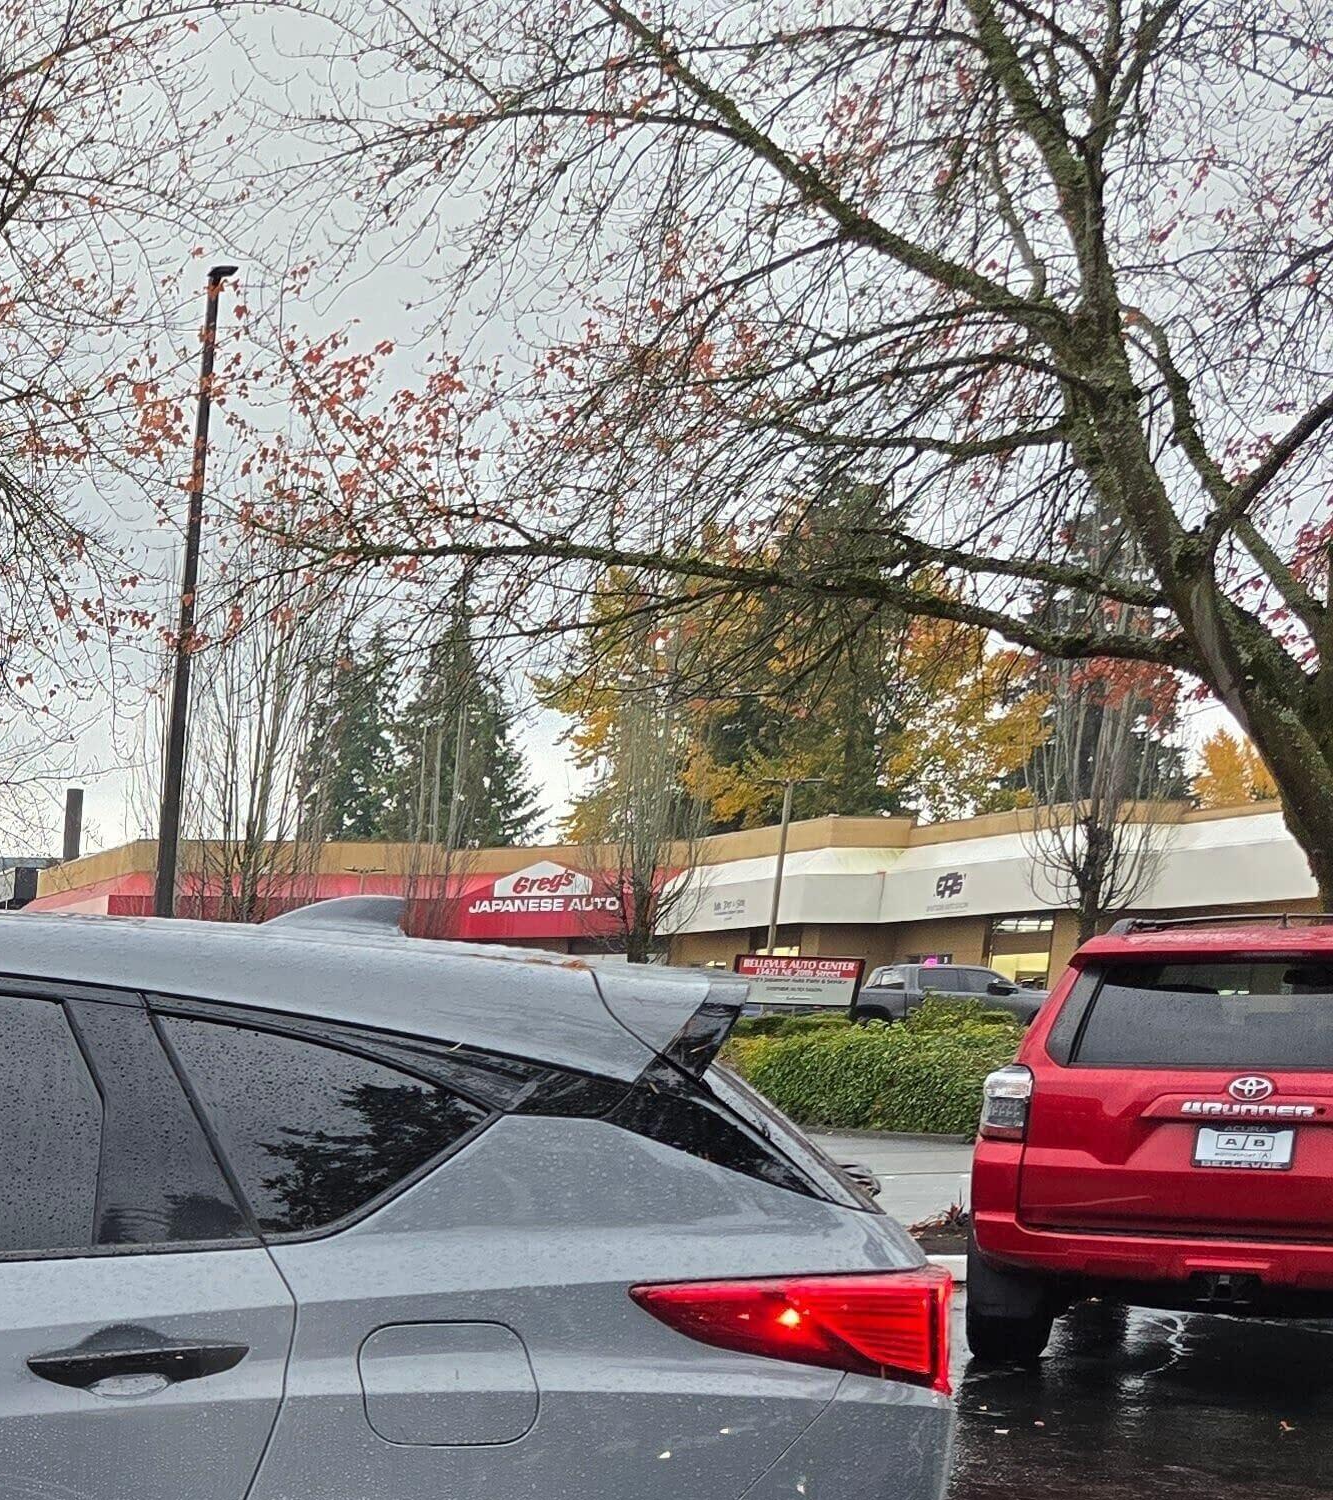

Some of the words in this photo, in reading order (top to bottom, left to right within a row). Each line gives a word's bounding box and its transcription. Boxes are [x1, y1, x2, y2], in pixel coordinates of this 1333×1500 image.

[512, 869, 576, 895] Greg's
[468, 898, 565, 914] JAPANESE
[568, 897, 620, 912] AUTO
[743, 959, 787, 969] BELLEVUE
[788, 960, 817, 970] AUTO
[819, 961, 855, 971] CENTER
[781, 968, 792, 976] NE
[794, 968, 814, 977] 20th
[815, 969, 841, 978] Street
[1180, 1101, 1315, 1118] 4RUNNER
[1224, 1125, 1268, 1133] ACURA
[1225, 1139, 1237, 1147] A
[1253, 1140, 1266, 1148] B
[1200, 1159, 1283, 1169] BELLEVUE
